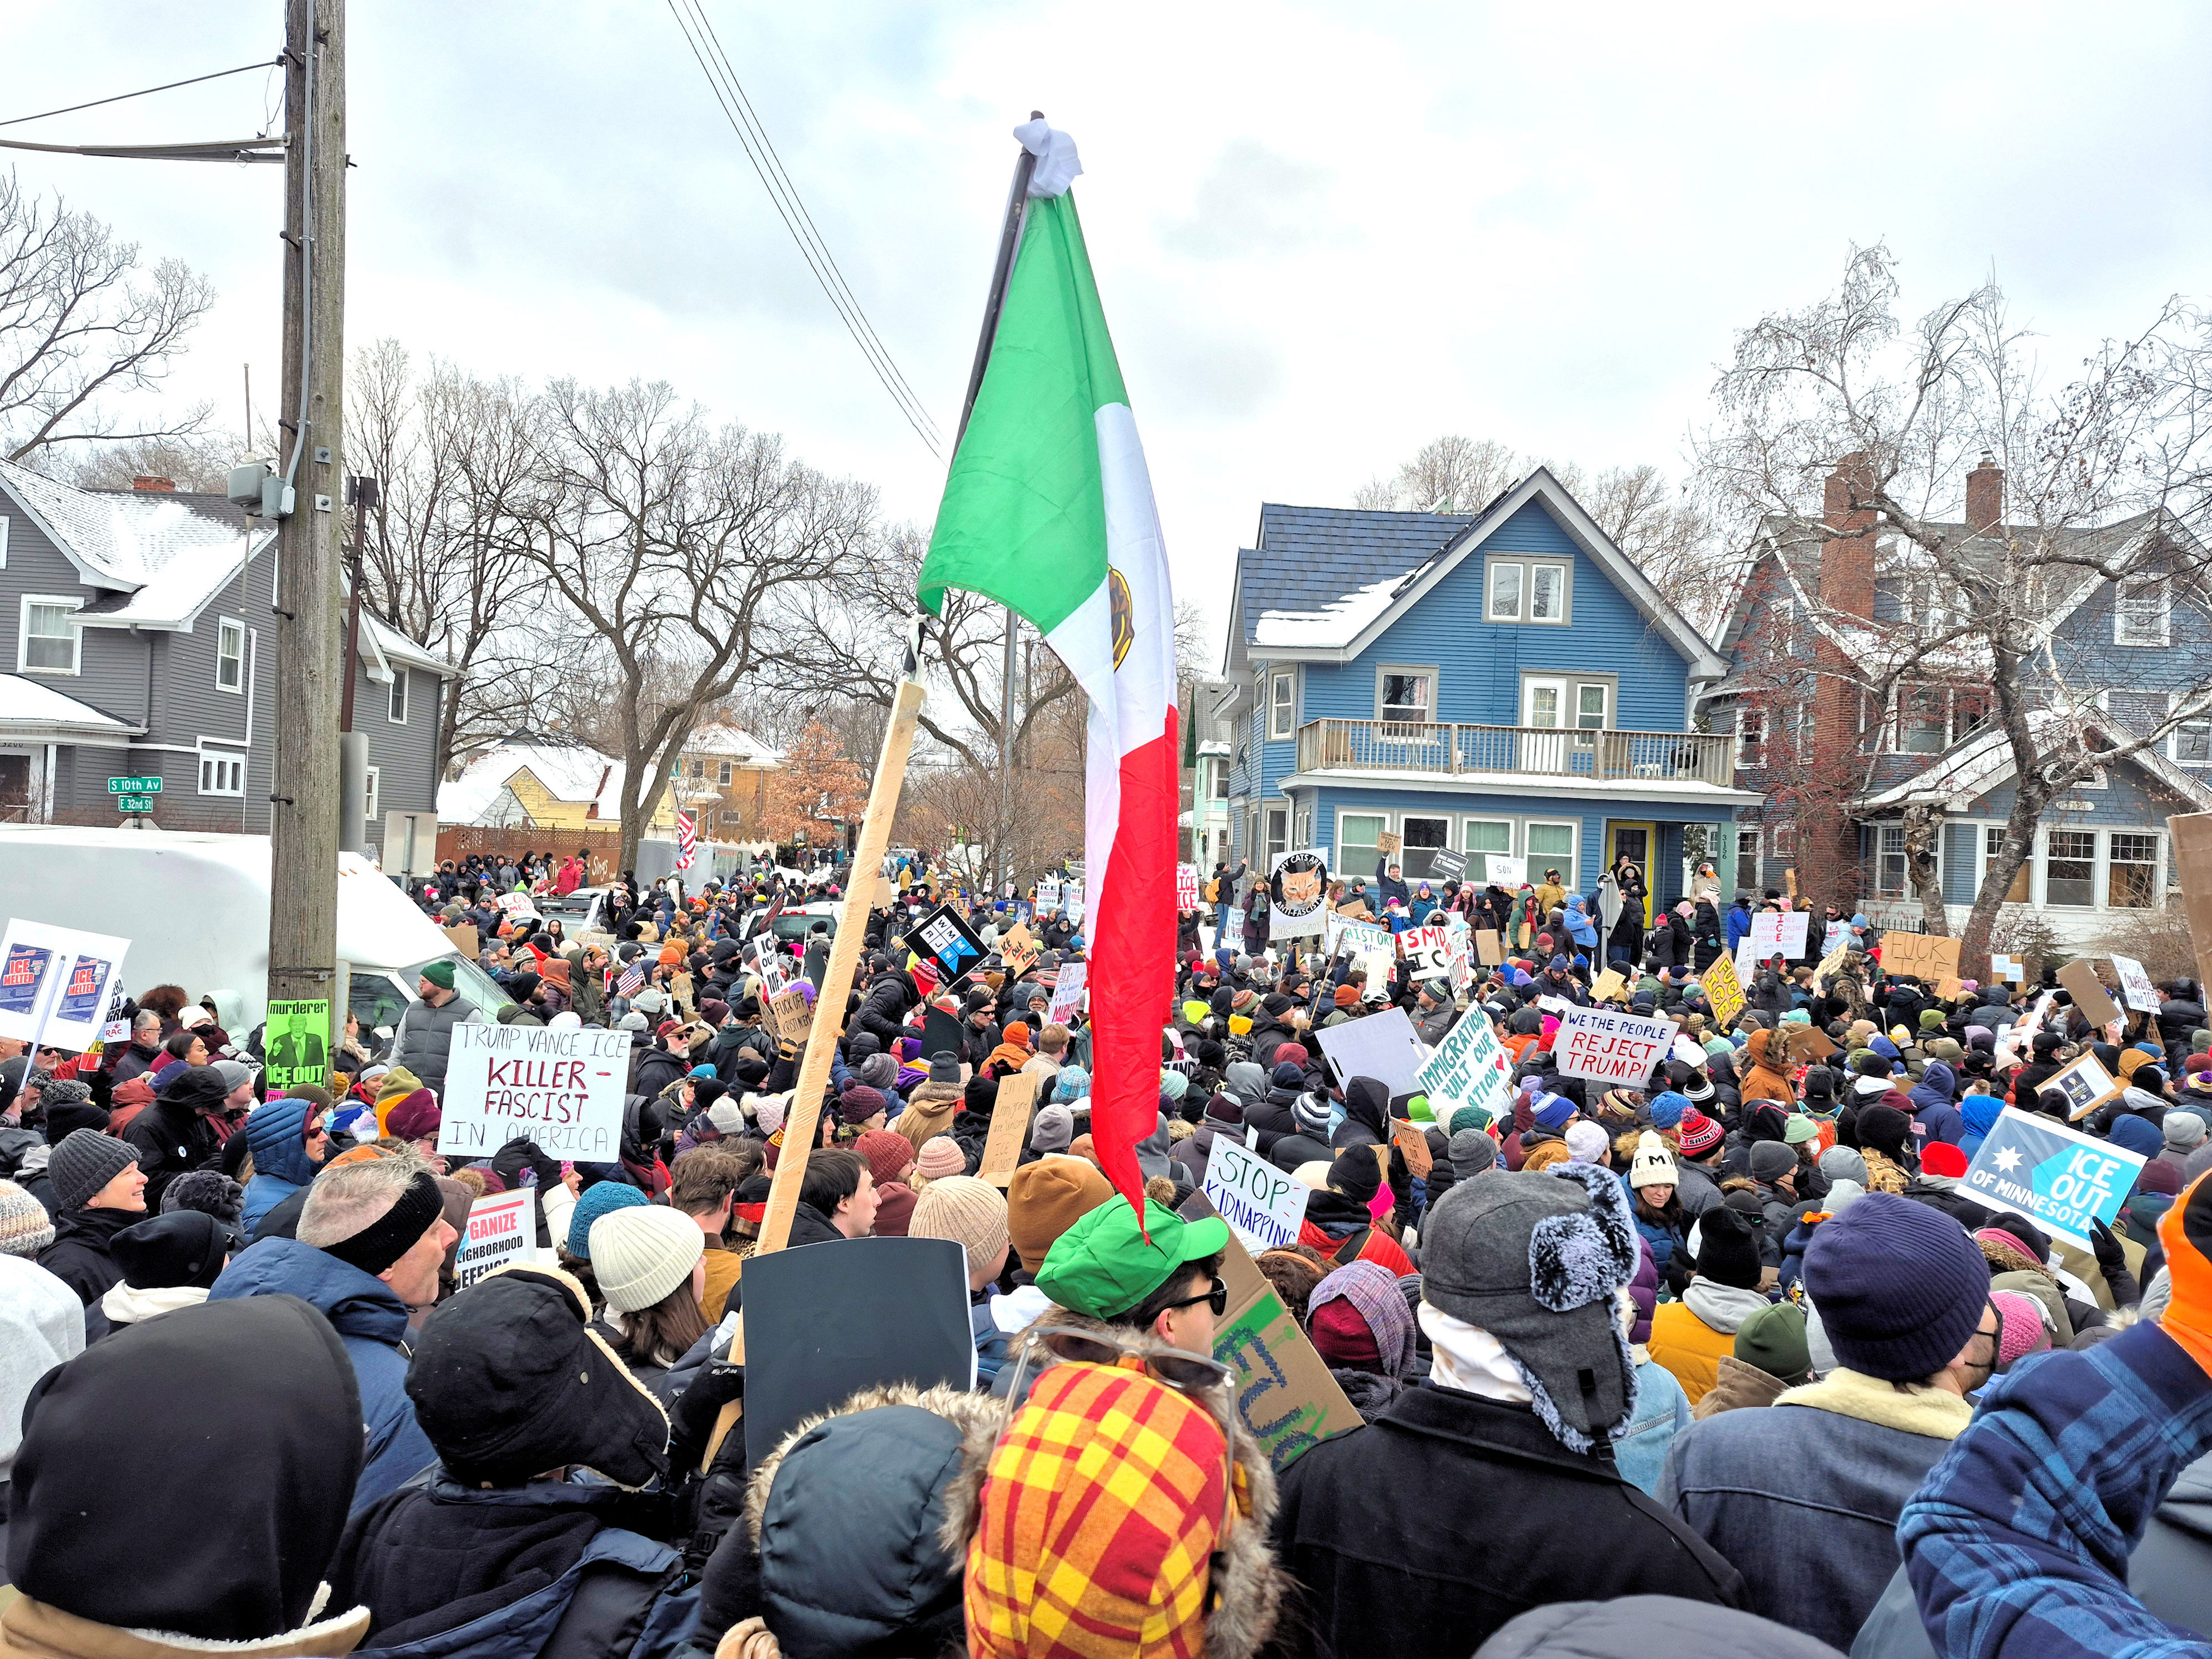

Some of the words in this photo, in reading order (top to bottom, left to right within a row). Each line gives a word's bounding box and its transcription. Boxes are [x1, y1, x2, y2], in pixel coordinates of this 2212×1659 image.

[112, 781, 117, 790] S
[121, 780, 142, 790] 10th
[146, 780, 159, 789] Av
[121, 800, 124, 809] E
[127, 800, 142, 809] 32nd
[144, 800, 152, 809] St
[1279, 861, 1289, 872] MY
[1291, 854, 1309, 863] CATS
[1309, 857, 1322, 867] ARE
[1496, 865, 1511, 874] SON
[1179, 876, 1197, 891] ICE
[502, 894, 530, 906] LOV
[1177, 892, 1197, 909] ICE
[1276, 924, 1299, 938] ICE
[1300, 921, 1324, 934] OUT
[1347, 928, 1394, 947] HISTORY
[1407, 927, 1446, 948] SMD
[760, 937, 774, 953] IC
[1001, 937, 1012, 953] ICE
[1012, 941, 1023, 957] out
[1891, 932, 1948, 961] FUCK
[1022, 948, 1034, 963] now
[1408, 949, 1444, 972] IC
[10, 959, 30, 974] ICE
[1892, 957, 1951, 981] ICE
[4, 973, 34, 985] MELTER
[75, 970, 92, 983] ICE
[1718, 957, 1744, 1012] FUCK
[69, 983, 95, 995] MELTER
[1705, 971, 1731, 1021] ICE
[110, 996, 121, 1010] LA
[270, 1002, 326, 1014] murderer
[775, 996, 794, 1018] FUCK
[792, 992, 804, 1010] OFF
[783, 1017, 798, 1036] KRISTI
[1569, 1012, 1587, 1026] WE
[1591, 1016, 1615, 1030] THE
[1620, 1021, 1667, 1040] PEOPLE
[456, 1024, 520, 1050] TRUMP
[527, 1030, 581, 1056] VANCE
[589, 1034, 629, 1058] ICE
[1419, 1006, 1486, 1095] IMMIGRATION
[1474, 1032, 1495, 1063] OUR
[1571, 1032, 1657, 1060] REJECT
[268, 1067, 292, 1083] ICE
[293, 1065, 325, 1083] OUT
[488, 1057, 586, 1089] KILLER
[1568, 1052, 1647, 1081] TRUMP!
[1004, 1079, 1015, 1094] In
[1019, 1077, 1033, 1092] MN
[1467, 1063, 1500, 1107] ATION
[485, 1089, 589, 1123] FASCIST
[446, 1121, 485, 1146] IN
[994, 1123, 1003, 1133] are
[1689, 1130, 1715, 1145] SAINT
[995, 1142, 1010, 1156] ICE
[999, 1158, 1011, 1170] NOT
[2066, 1149, 2121, 1189] ICE
[1218, 1151, 1289, 1210] STOP
[1972, 1170, 1997, 1188] OF
[1994, 1177, 2096, 1233] MINNESOTA
[2050, 1174, 2113, 1215] OUT
[466, 1212, 517, 1240] GANIZE
[458, 1236, 523, 1263] IGHBORHOOD
